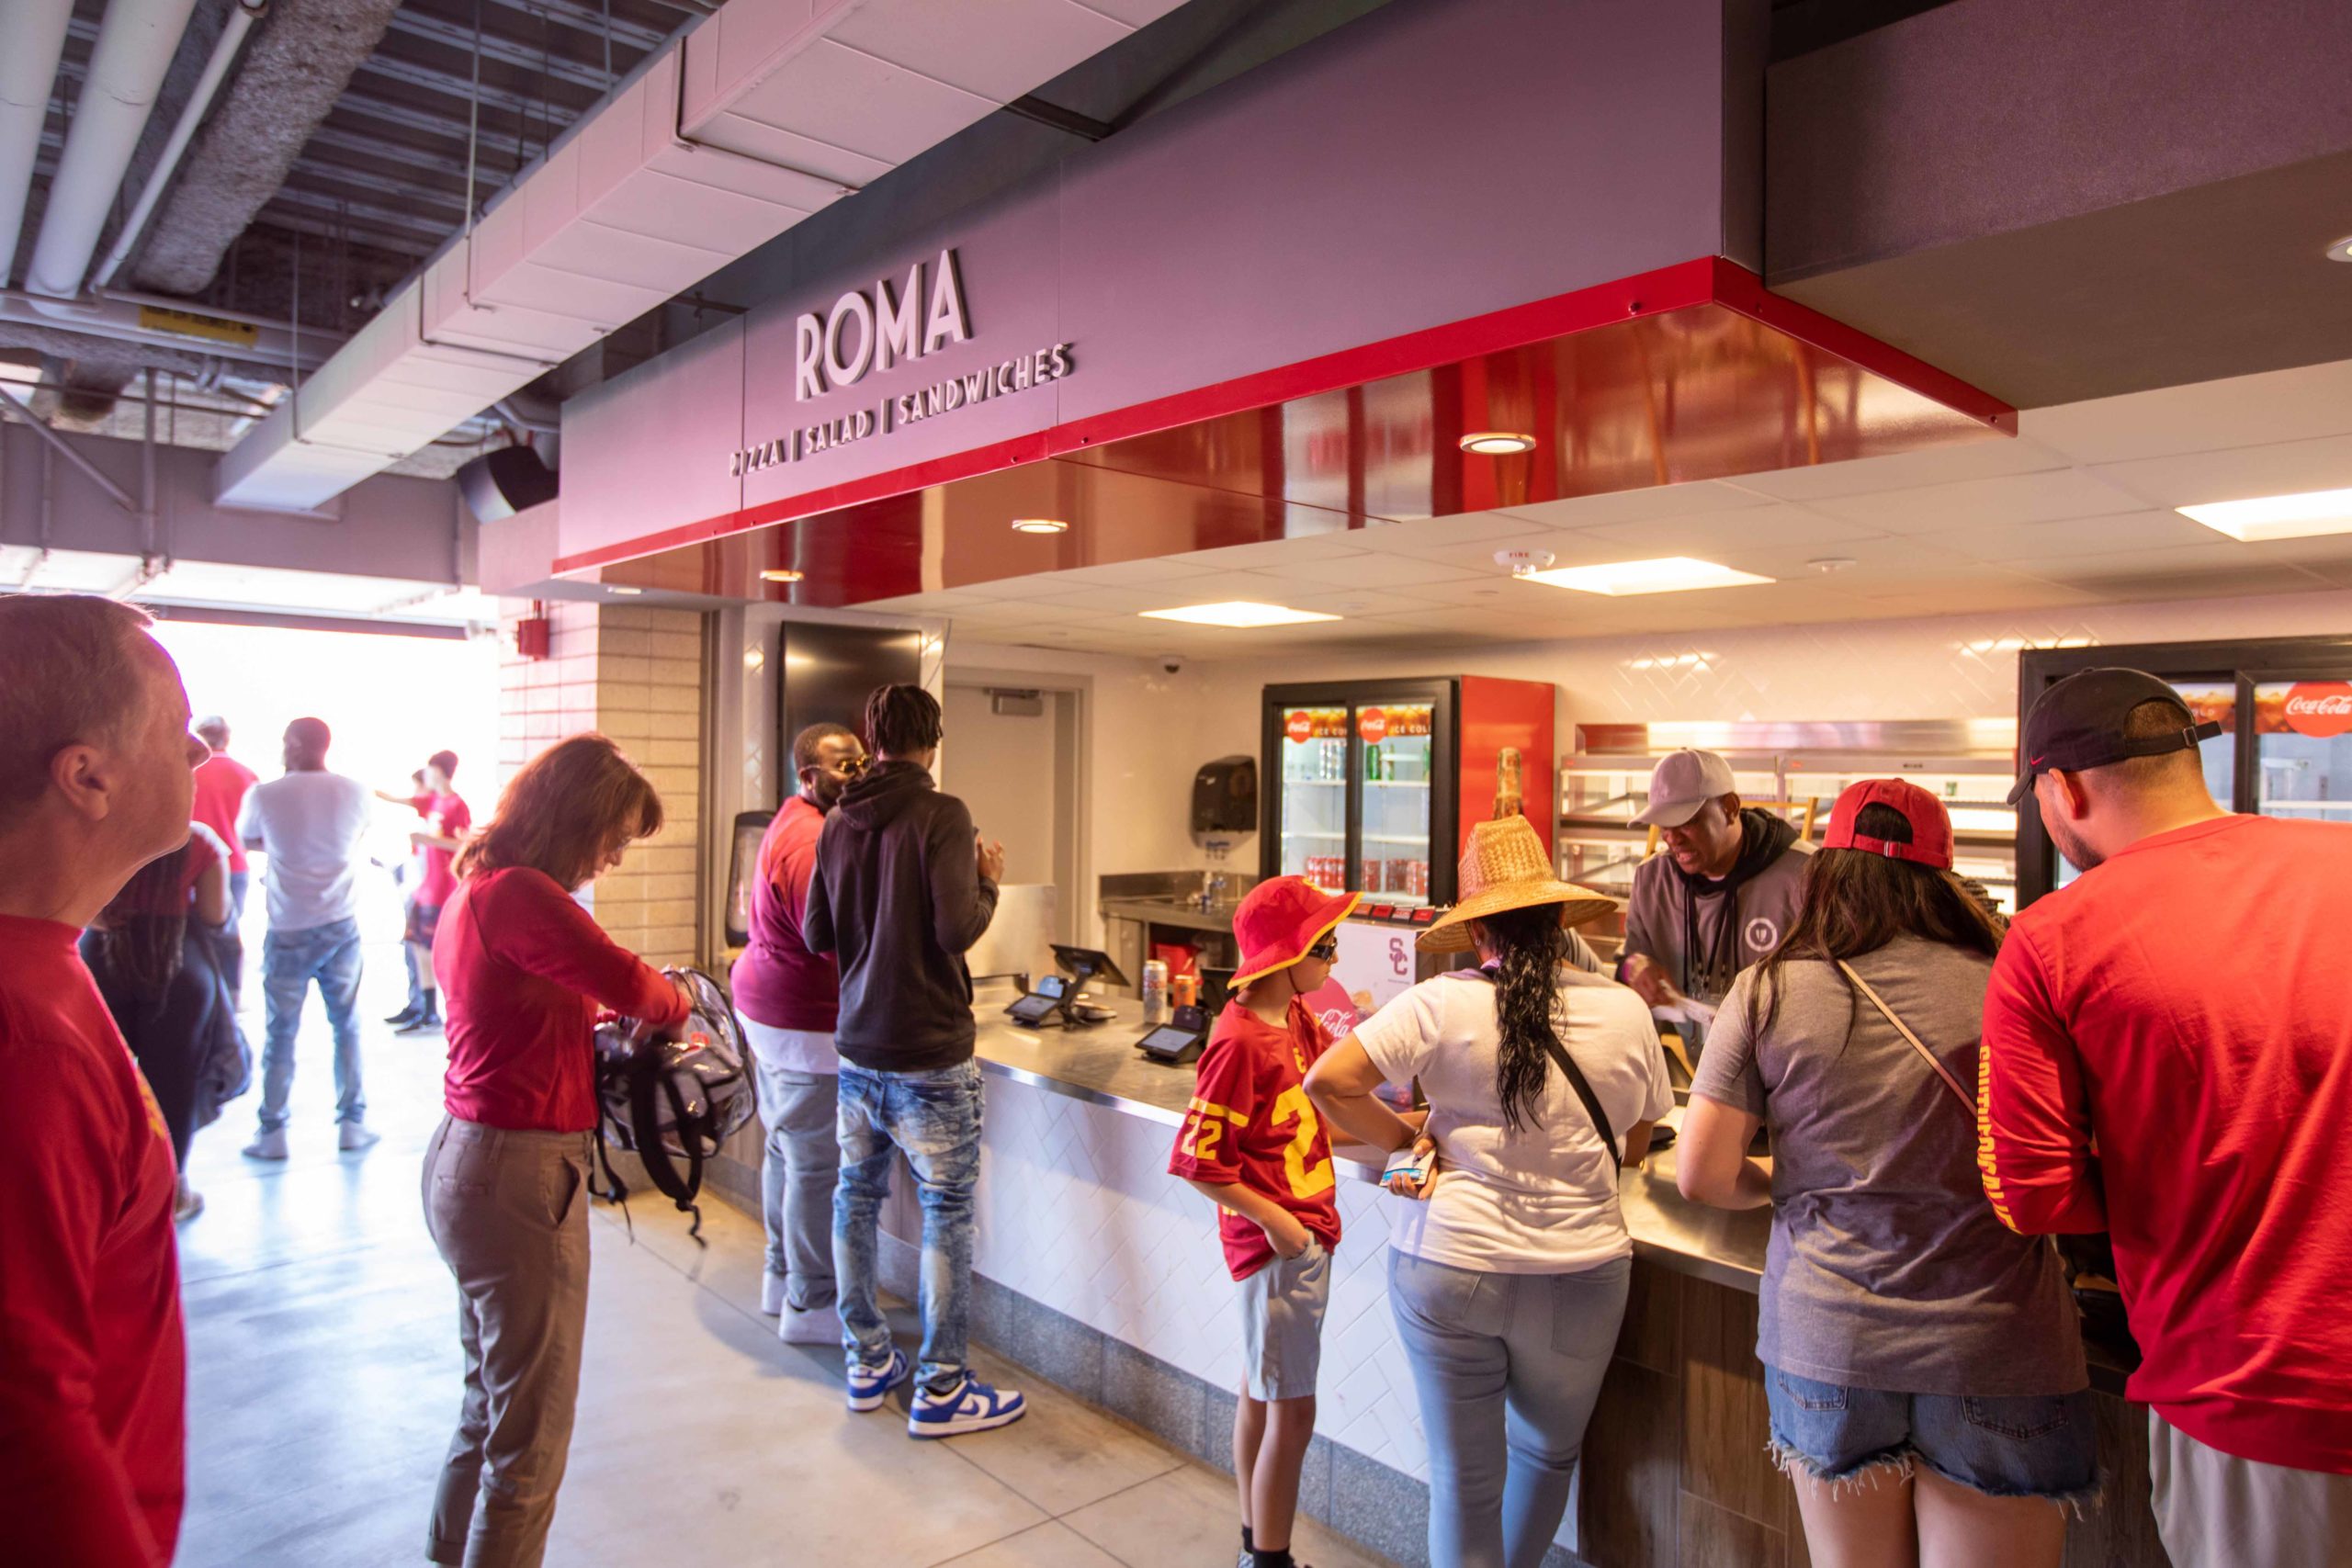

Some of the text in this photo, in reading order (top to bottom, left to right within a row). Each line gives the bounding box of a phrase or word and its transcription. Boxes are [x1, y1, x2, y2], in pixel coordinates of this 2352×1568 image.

[796, 249, 971, 401] ROMA
[729, 439, 785, 477] PIZZA
[806, 410, 875, 454] SALAD
[899, 344, 1073, 424] SANDWICHES
[2286, 695, 2352, 715] Coca-Cola
[1409, 724, 1430, 733] COL
[1181, 1114, 1223, 1160] 22
